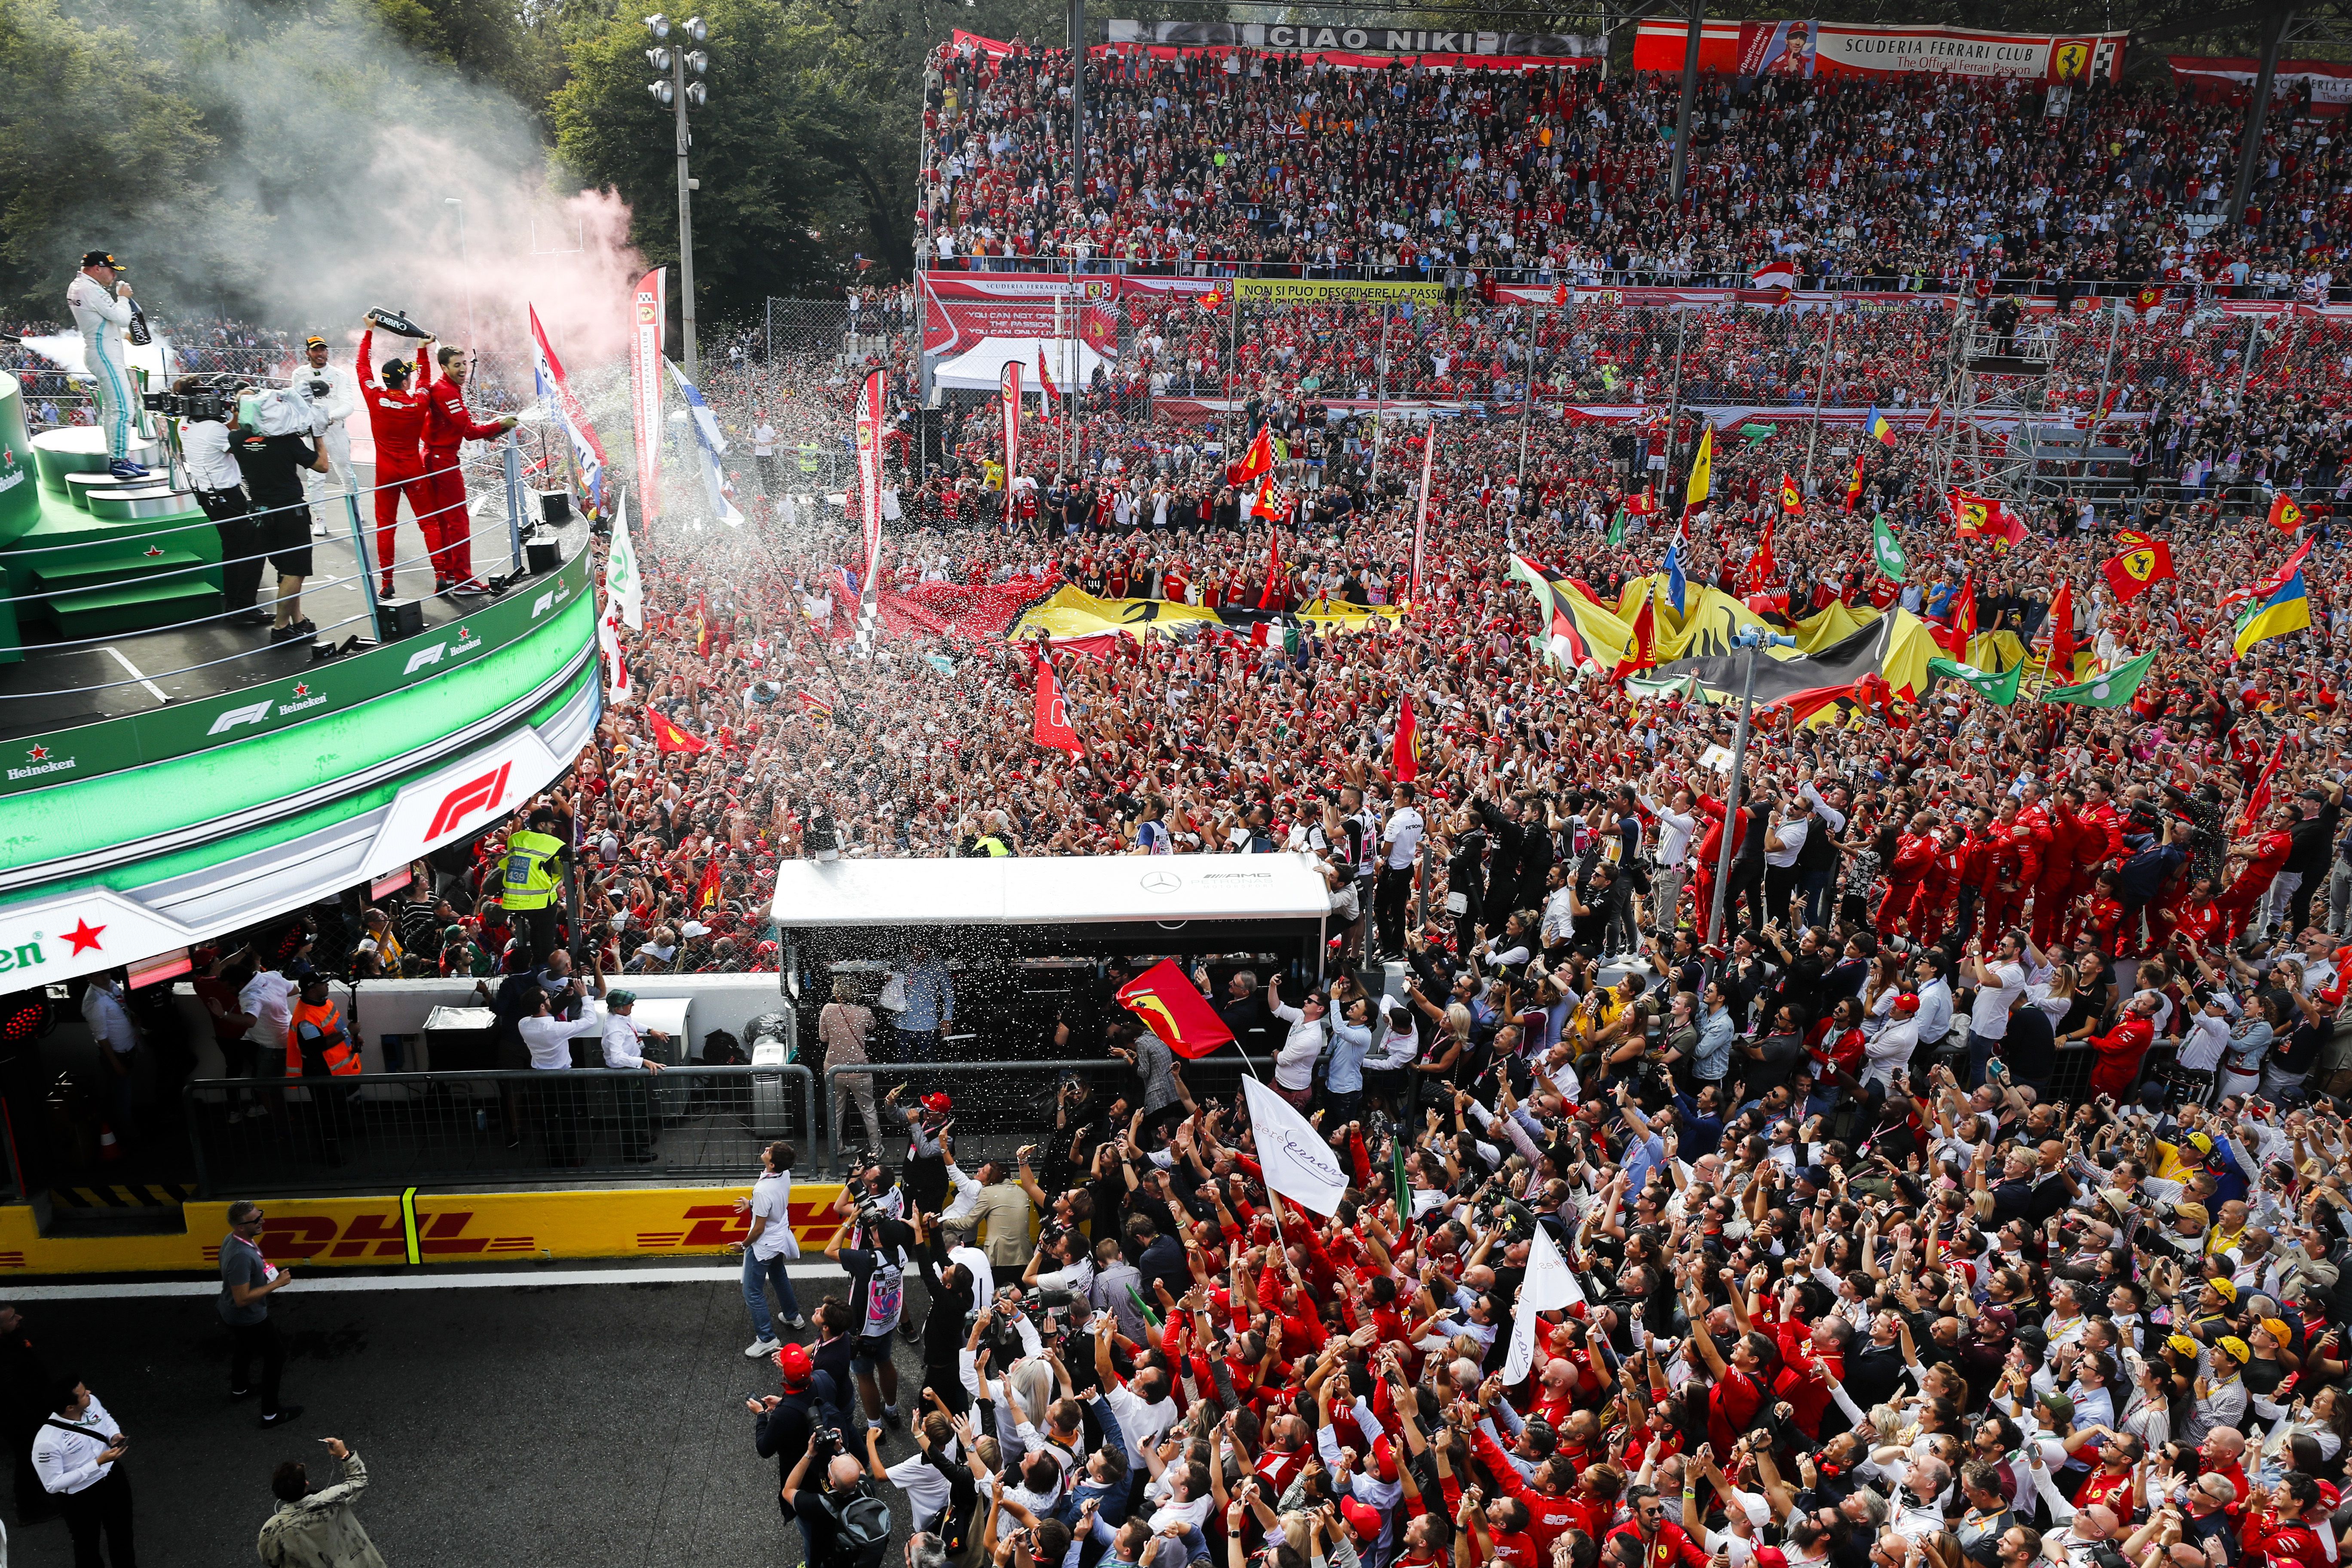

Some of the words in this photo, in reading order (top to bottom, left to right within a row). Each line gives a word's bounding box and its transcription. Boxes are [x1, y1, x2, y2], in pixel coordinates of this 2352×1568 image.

[1270, 27, 1368, 49] CIAO
[1387, 31, 1472, 52] NIKI
[1757, 36, 1768, 55] Godere
[1740, 27, 1766, 74] #DajeCarletto
[1846, 39, 1922, 54] SCUDERIA
[1930, 41, 1990, 58] FERRARI
[1997, 47, 2033, 61] CLUB
[1897, 56, 1916, 68] The
[1919, 57, 1956, 70] Official
[1960, 59, 1990, 72] Ferrari
[1993, 63, 2030, 74] Passion
[1276, 286, 1285, 296] SI
[1320, 287, 1389, 298] DESCRIVERE
[1393, 288, 1406, 298] LA
[377, 314, 407, 331] CARBO
[631, 332, 643, 439] www.scuderiaferrari.club
[1088, 580, 1100, 589] 44
[450, 637, 481, 656] Heineken
[279, 693, 327, 716] Heineken
[7, 758, 76, 780] Heineken
[508, 871, 525, 881] 439
